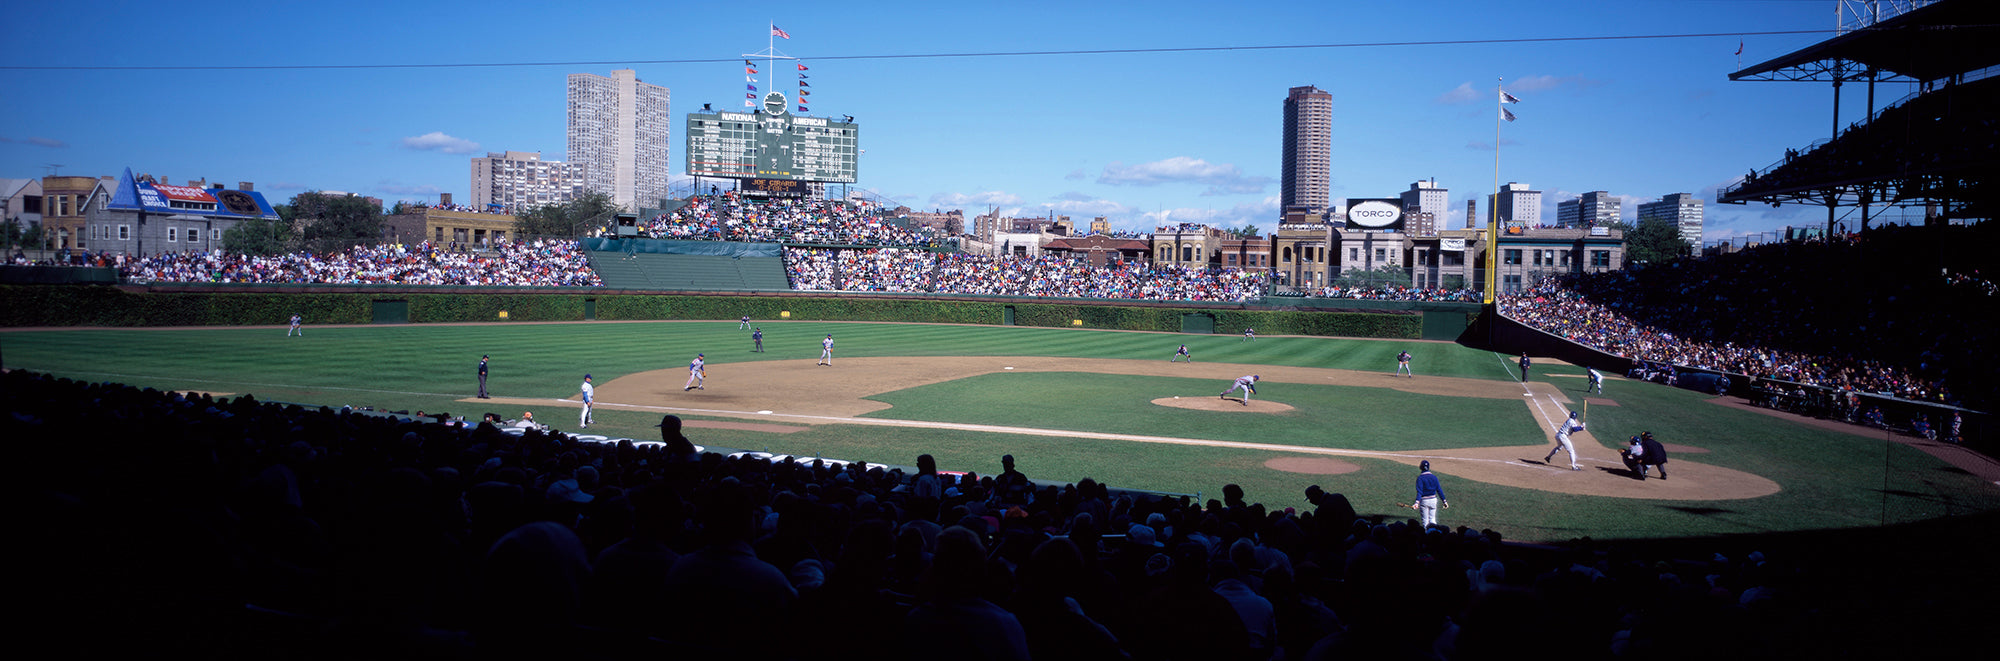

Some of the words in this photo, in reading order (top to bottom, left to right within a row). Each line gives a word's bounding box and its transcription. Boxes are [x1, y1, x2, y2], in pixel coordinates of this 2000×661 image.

[722, 112, 757, 122] NATIONAL
[793, 117, 827, 127] AMERICAN
[1355, 210, 1394, 218] TORCO
